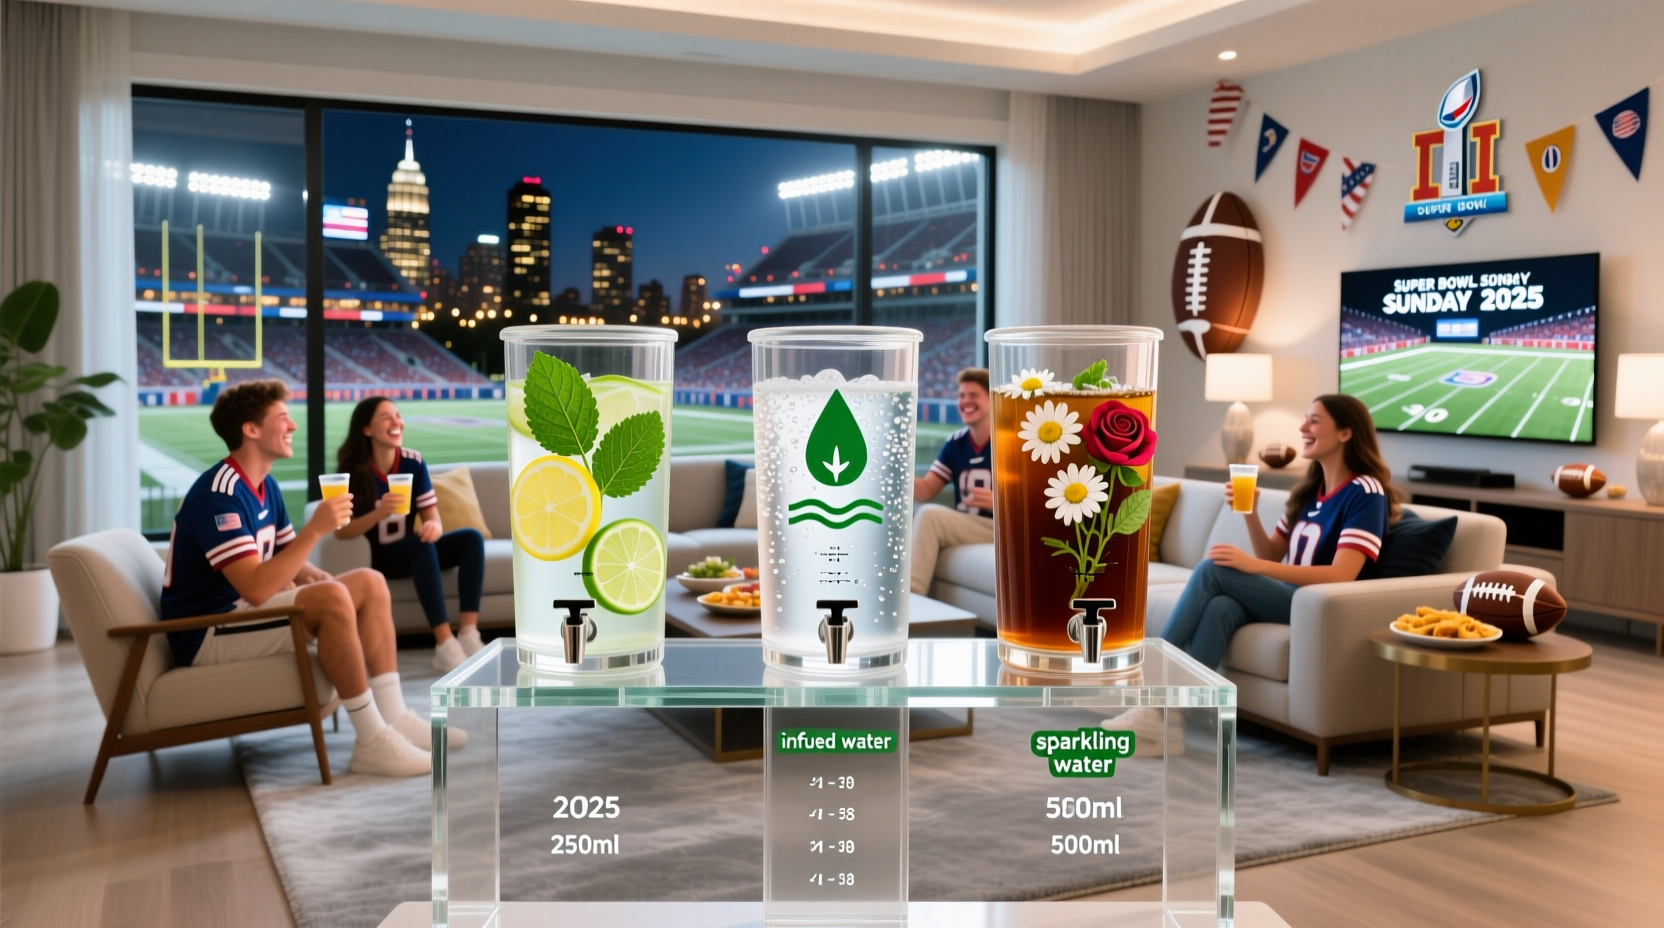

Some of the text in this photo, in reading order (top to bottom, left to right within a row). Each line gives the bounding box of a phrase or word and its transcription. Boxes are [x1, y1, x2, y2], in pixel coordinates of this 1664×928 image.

[1394, 278, 1435, 293] SUPER
[1437, 275, 1478, 291] BOWL
[1382, 285, 1544, 315] SUNDAY 2025
[781, 731, 892, 749] infued water
[1036, 731, 1130, 754] sparkling
[1054, 756, 1113, 773] water
[552, 795, 621, 819] 2025
[550, 833, 620, 855] 250ml
[1050, 833, 1120, 855] 500ml
